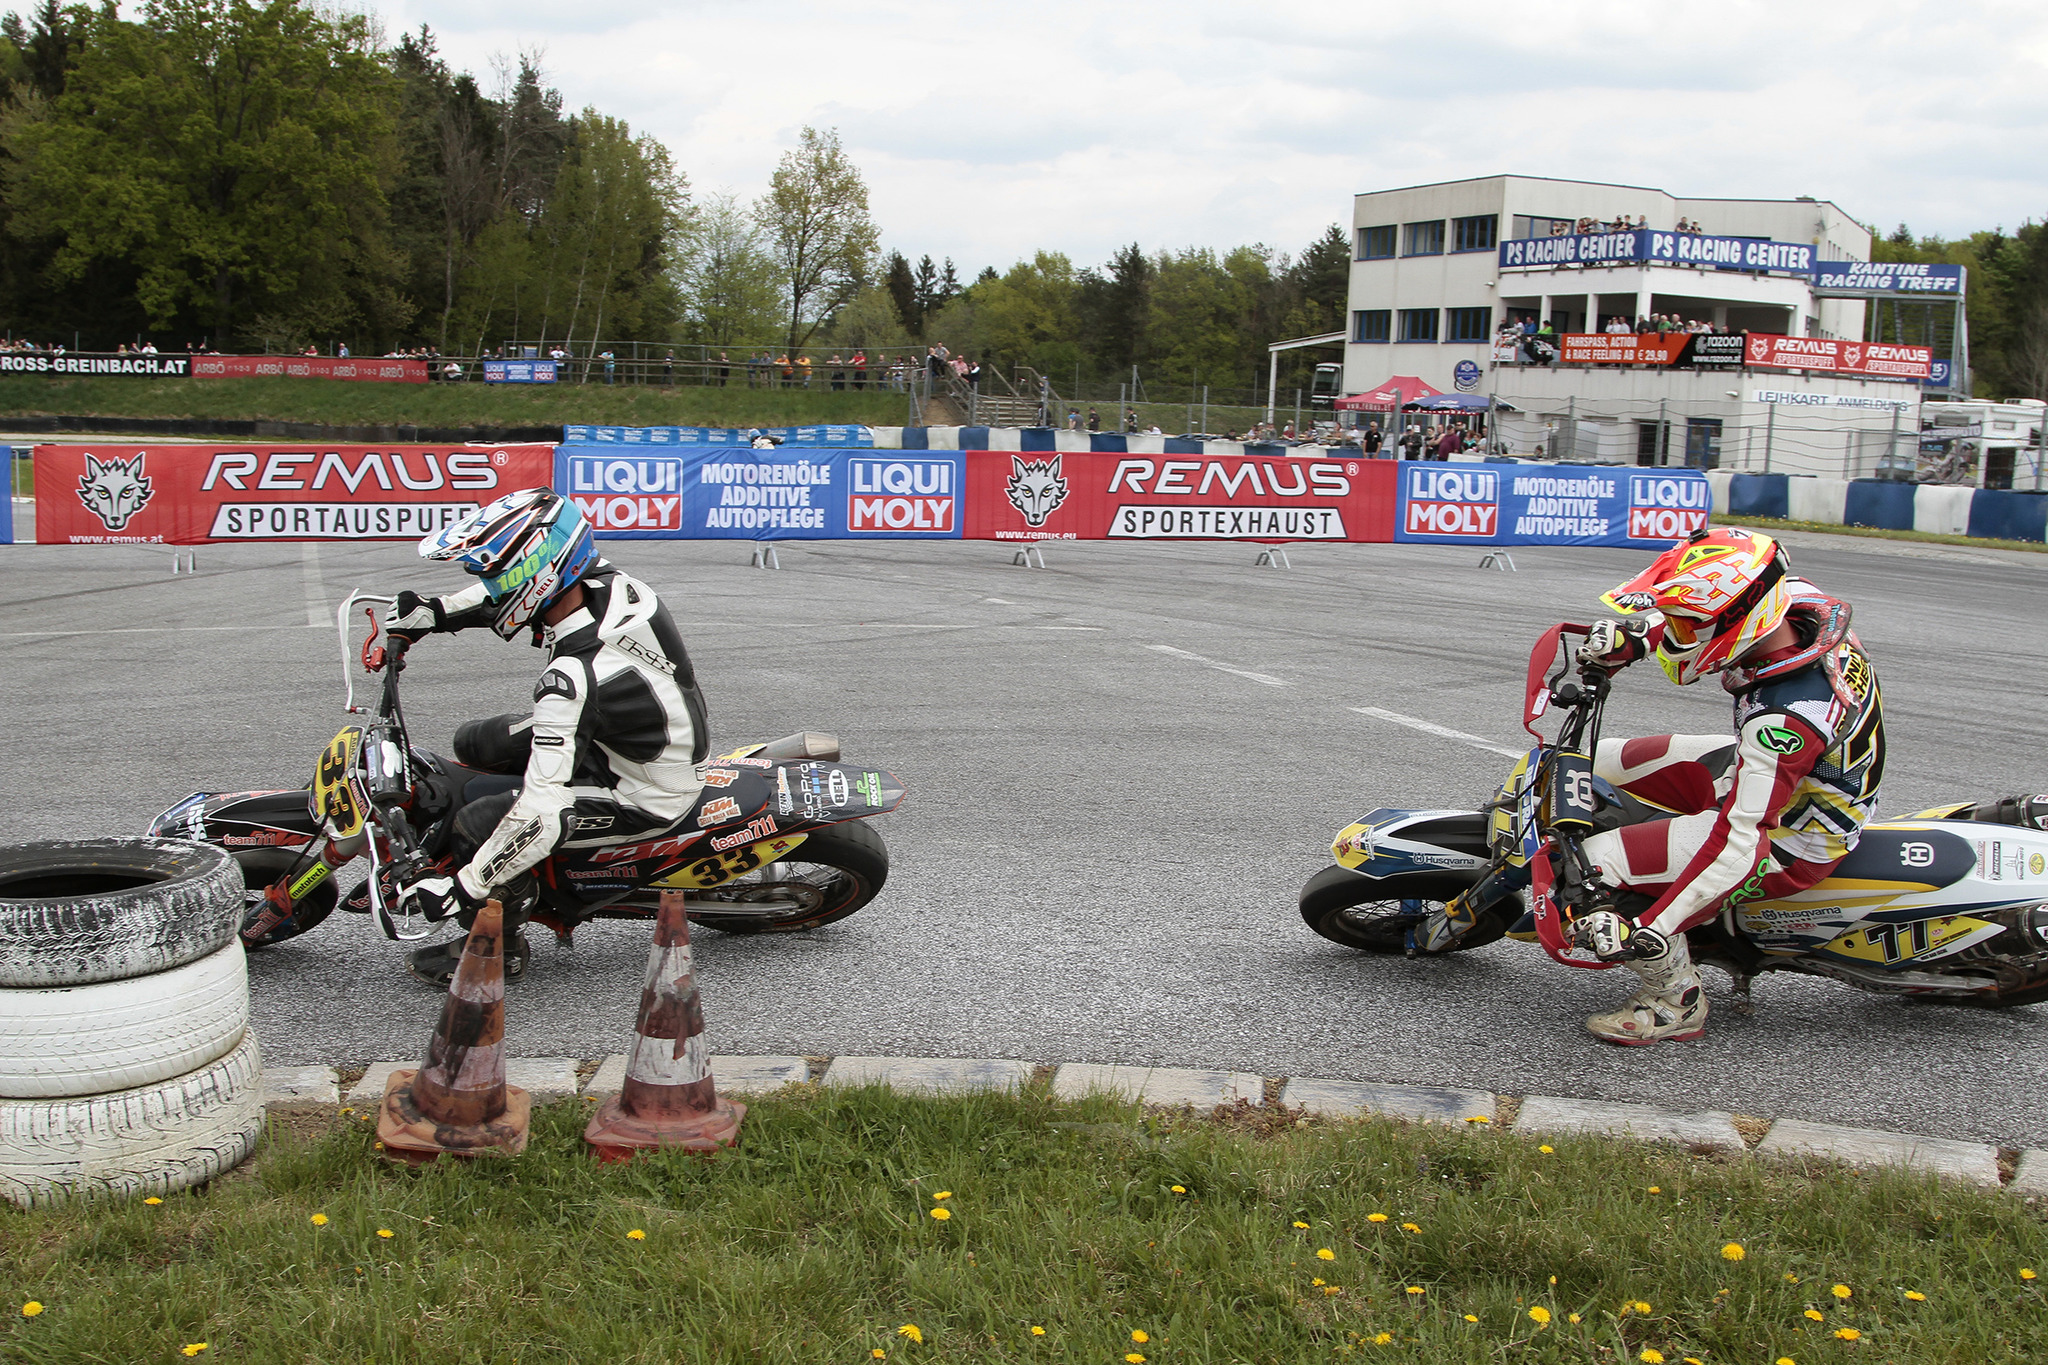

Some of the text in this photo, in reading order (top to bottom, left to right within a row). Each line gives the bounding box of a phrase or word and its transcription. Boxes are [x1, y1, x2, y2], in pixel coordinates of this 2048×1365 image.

[1506, 233, 1635, 265] PS RACING CENTER
[1652, 233, 1810, 269] PS RACING CENTER
[1849, 262, 1930, 276] KANTINE
[1819, 274, 1957, 290] RACING TREFF
[1610, 336, 1637, 348] ACTION
[1707, 336, 1743, 347] razoon
[1773, 338, 1837, 354] REMUS
[1572, 350, 1590, 360] RACE
[1592, 350, 1622, 360] FEELING
[1623, 350, 1634, 360] AB
[1776, 354, 1833, 368] SPORTAUSPUFF
[1866, 346, 1929, 361] REMUS
[0, 356, 187, 374] ROSS-GREINBACH.AT
[194, 361, 225, 374] ARBÖ
[286, 363, 310, 375] ARBÖ
[332, 364, 357, 377] ARBÖ
[379, 365, 404, 378] ARBÖ
[1868, 361, 1925, 375] SPORTAUSPUFF
[486, 372, 505, 380] MOLY
[535, 372, 554, 380] MOLY
[1758, 391, 1829, 406] LEIHKART
[201, 452, 498, 492] REMUS
[575, 460, 678, 495] LIQUI
[701, 460, 831, 486] MOTORENÖLE
[854, 462, 950, 498] LIQUI
[1107, 458, 1351, 498] REMUS
[720, 486, 811, 507] ADDITIVE
[1411, 470, 1495, 502] LIQUI
[1513, 474, 1615, 498] MOTORENÖLE
[1633, 478, 1708, 508] LIQUI
[579, 497, 679, 528] MOLY
[855, 498, 950, 529] MOLY
[1526, 497, 1598, 517] ADDITIVE
[705, 508, 825, 529] AUTOPFLEGE
[1124, 510, 1332, 535] SPORTEXHAUST
[1410, 503, 1496, 534] MOLY
[1514, 516, 1609, 537] AUTOPFLEGE
[1632, 508, 1707, 537] MOLY
[69, 534, 164, 545] www.remus.at
[995, 530, 1077, 541] www.remus.eu
[535, 577, 555, 598] BELL
[1828, 604, 1841, 632] Thermo
[800, 764, 814, 818] GoPro
[833, 772, 845, 803] BELL
[867, 773, 878, 806] ROCK OIL
[703, 799, 733, 816] KTM
[223, 833, 276, 846] team711
[710, 815, 778, 851] team711
[690, 845, 762, 887] 33
[1426, 856, 1475, 865] Husqvarna
[291, 867, 325, 898] mototech
[565, 865, 638, 879] team711
[1777, 907, 1841, 918] Husqvarna
[243, 909, 280, 939] team711
[1864, 920, 1929, 964] 77
